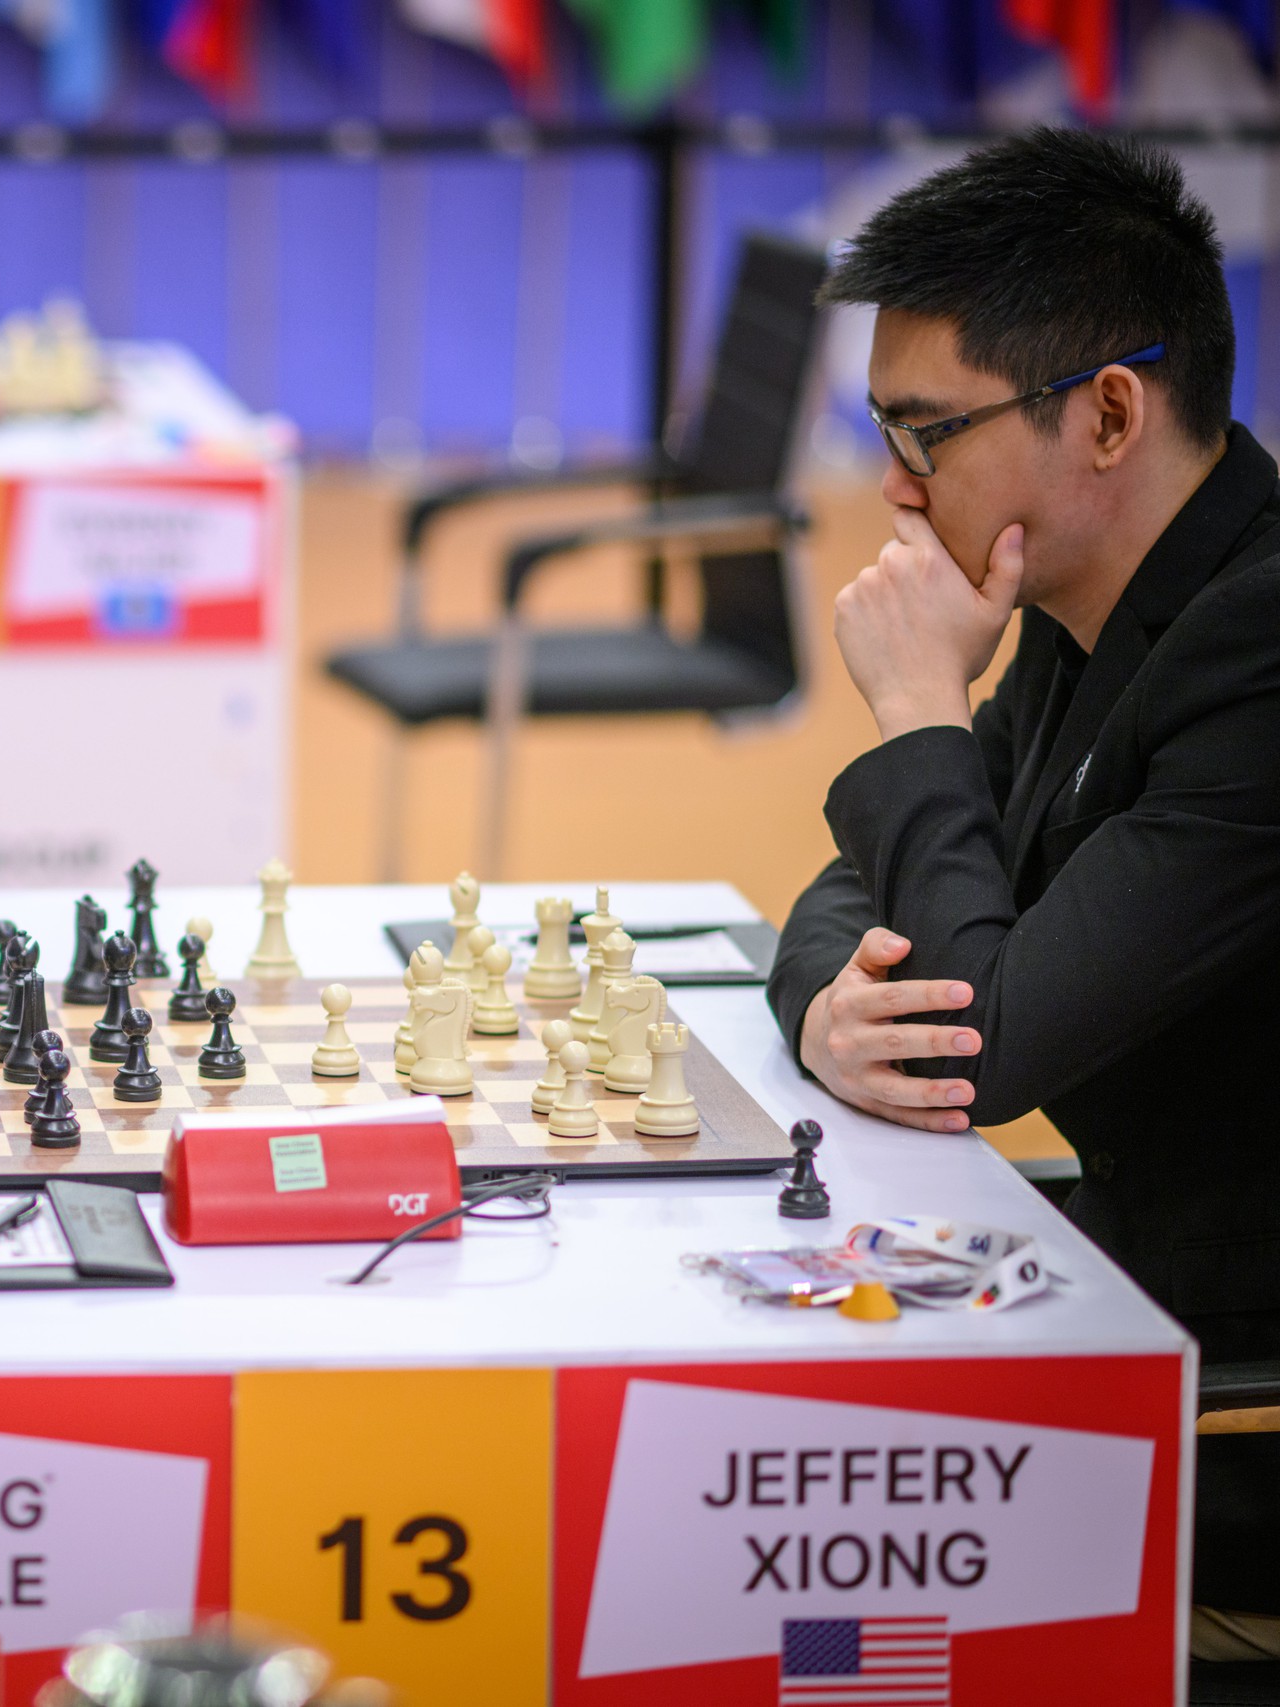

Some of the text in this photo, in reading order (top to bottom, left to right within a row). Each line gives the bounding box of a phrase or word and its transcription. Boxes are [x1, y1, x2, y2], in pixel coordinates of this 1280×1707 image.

[387, 1192, 431, 1216] DGT
[701, 1443, 1035, 1510] JEFFERY
[317, 1513, 475, 1624] 13
[742, 1527, 990, 1595] XIONG
